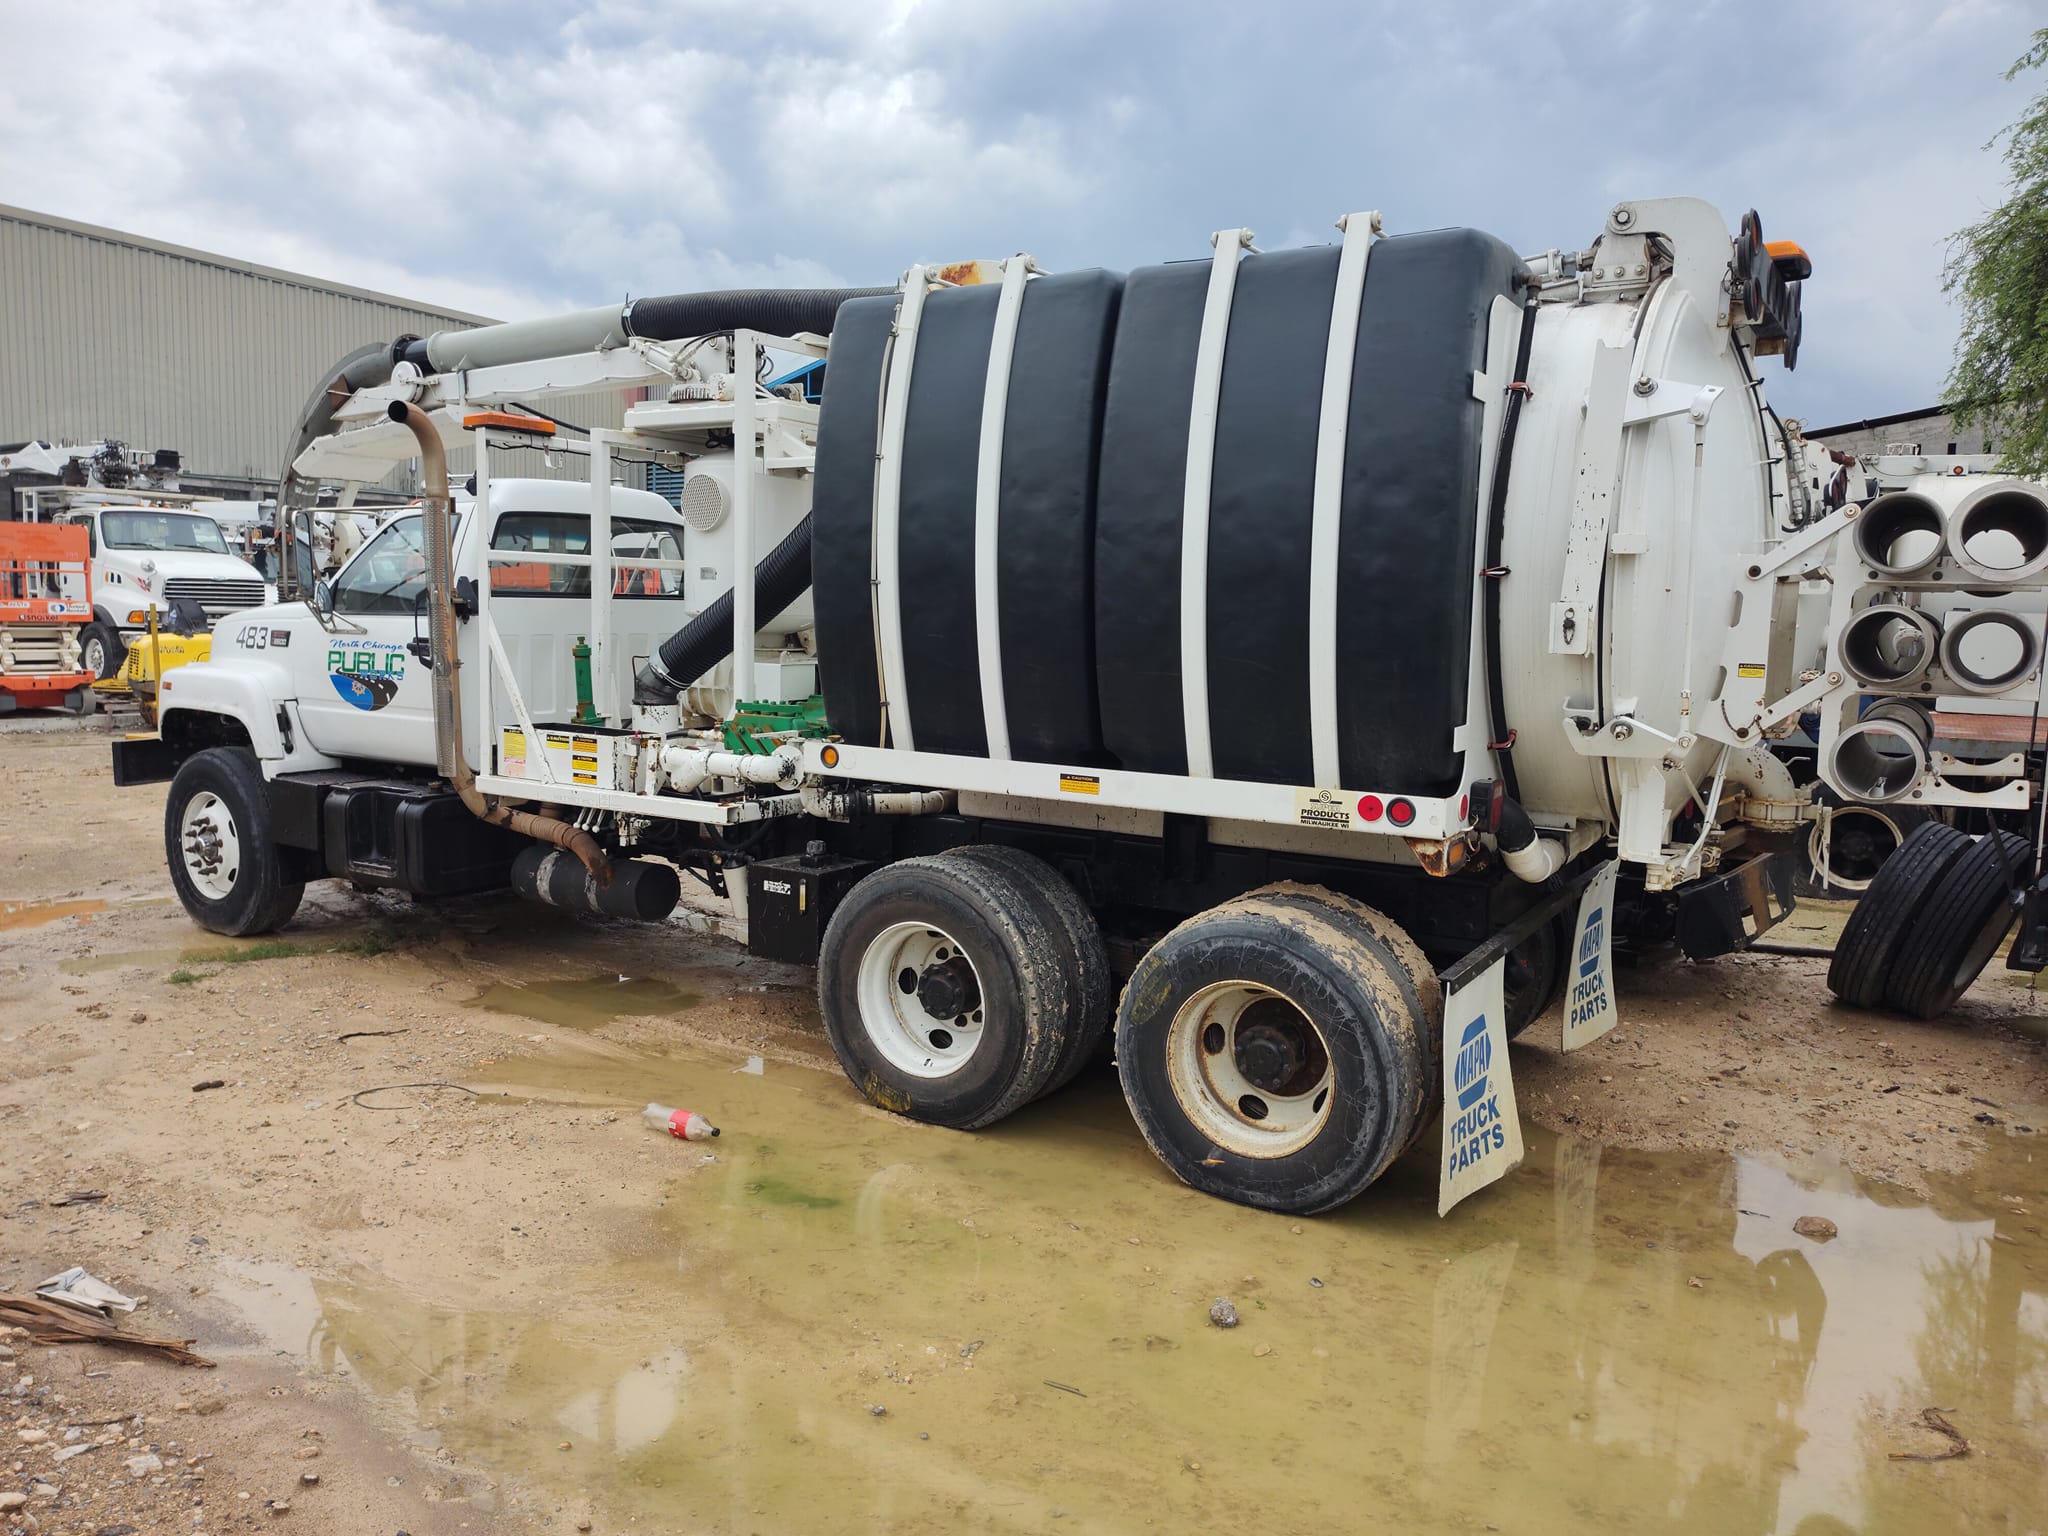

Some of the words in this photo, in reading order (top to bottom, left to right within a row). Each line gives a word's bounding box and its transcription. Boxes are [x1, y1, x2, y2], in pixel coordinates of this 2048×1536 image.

[236, 626, 268, 649] 483
[330, 639, 359, 648] North
[362, 641, 403, 652] Chicago
[328, 651, 405, 675] PUBLIC
[1301, 809, 1350, 820] PRODUCTS
[1301, 820, 1338, 828] MILWAUKEE
[1580, 923, 1601, 961] NAPA
[1573, 969, 1604, 1005] TRUCK
[1571, 992, 1607, 1029] PARTS
[1459, 1034, 1486, 1090] NAPA
[1451, 1094, 1500, 1148] TRUCK
[1450, 1123, 1504, 1180] PARTS
